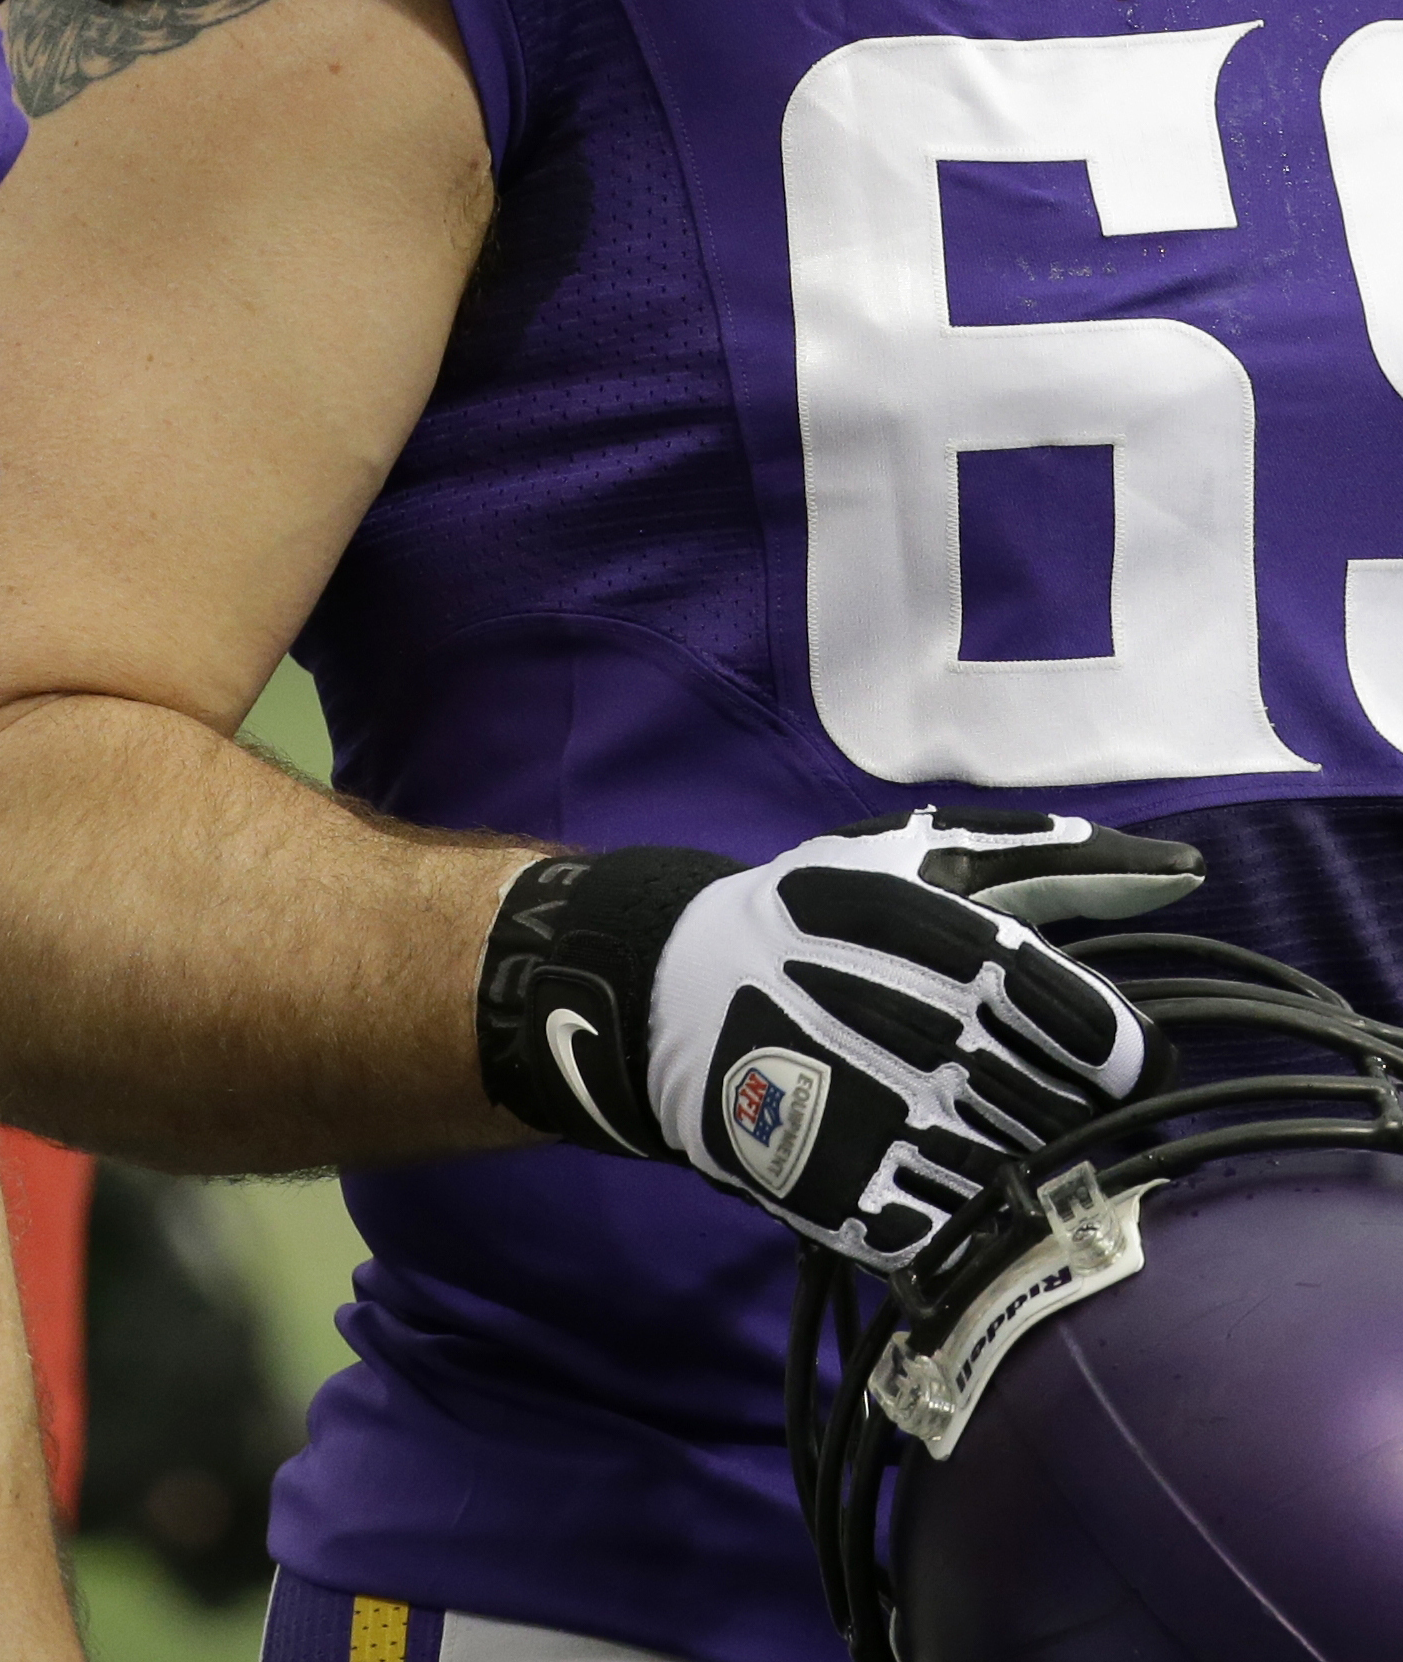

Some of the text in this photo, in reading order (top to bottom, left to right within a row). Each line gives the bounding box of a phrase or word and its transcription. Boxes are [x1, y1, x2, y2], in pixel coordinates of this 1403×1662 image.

[735, 1072, 770, 1126] NFL
[766, 1072, 815, 1178] EQUIPMENT
[954, 1265, 1073, 1393] Riddell
